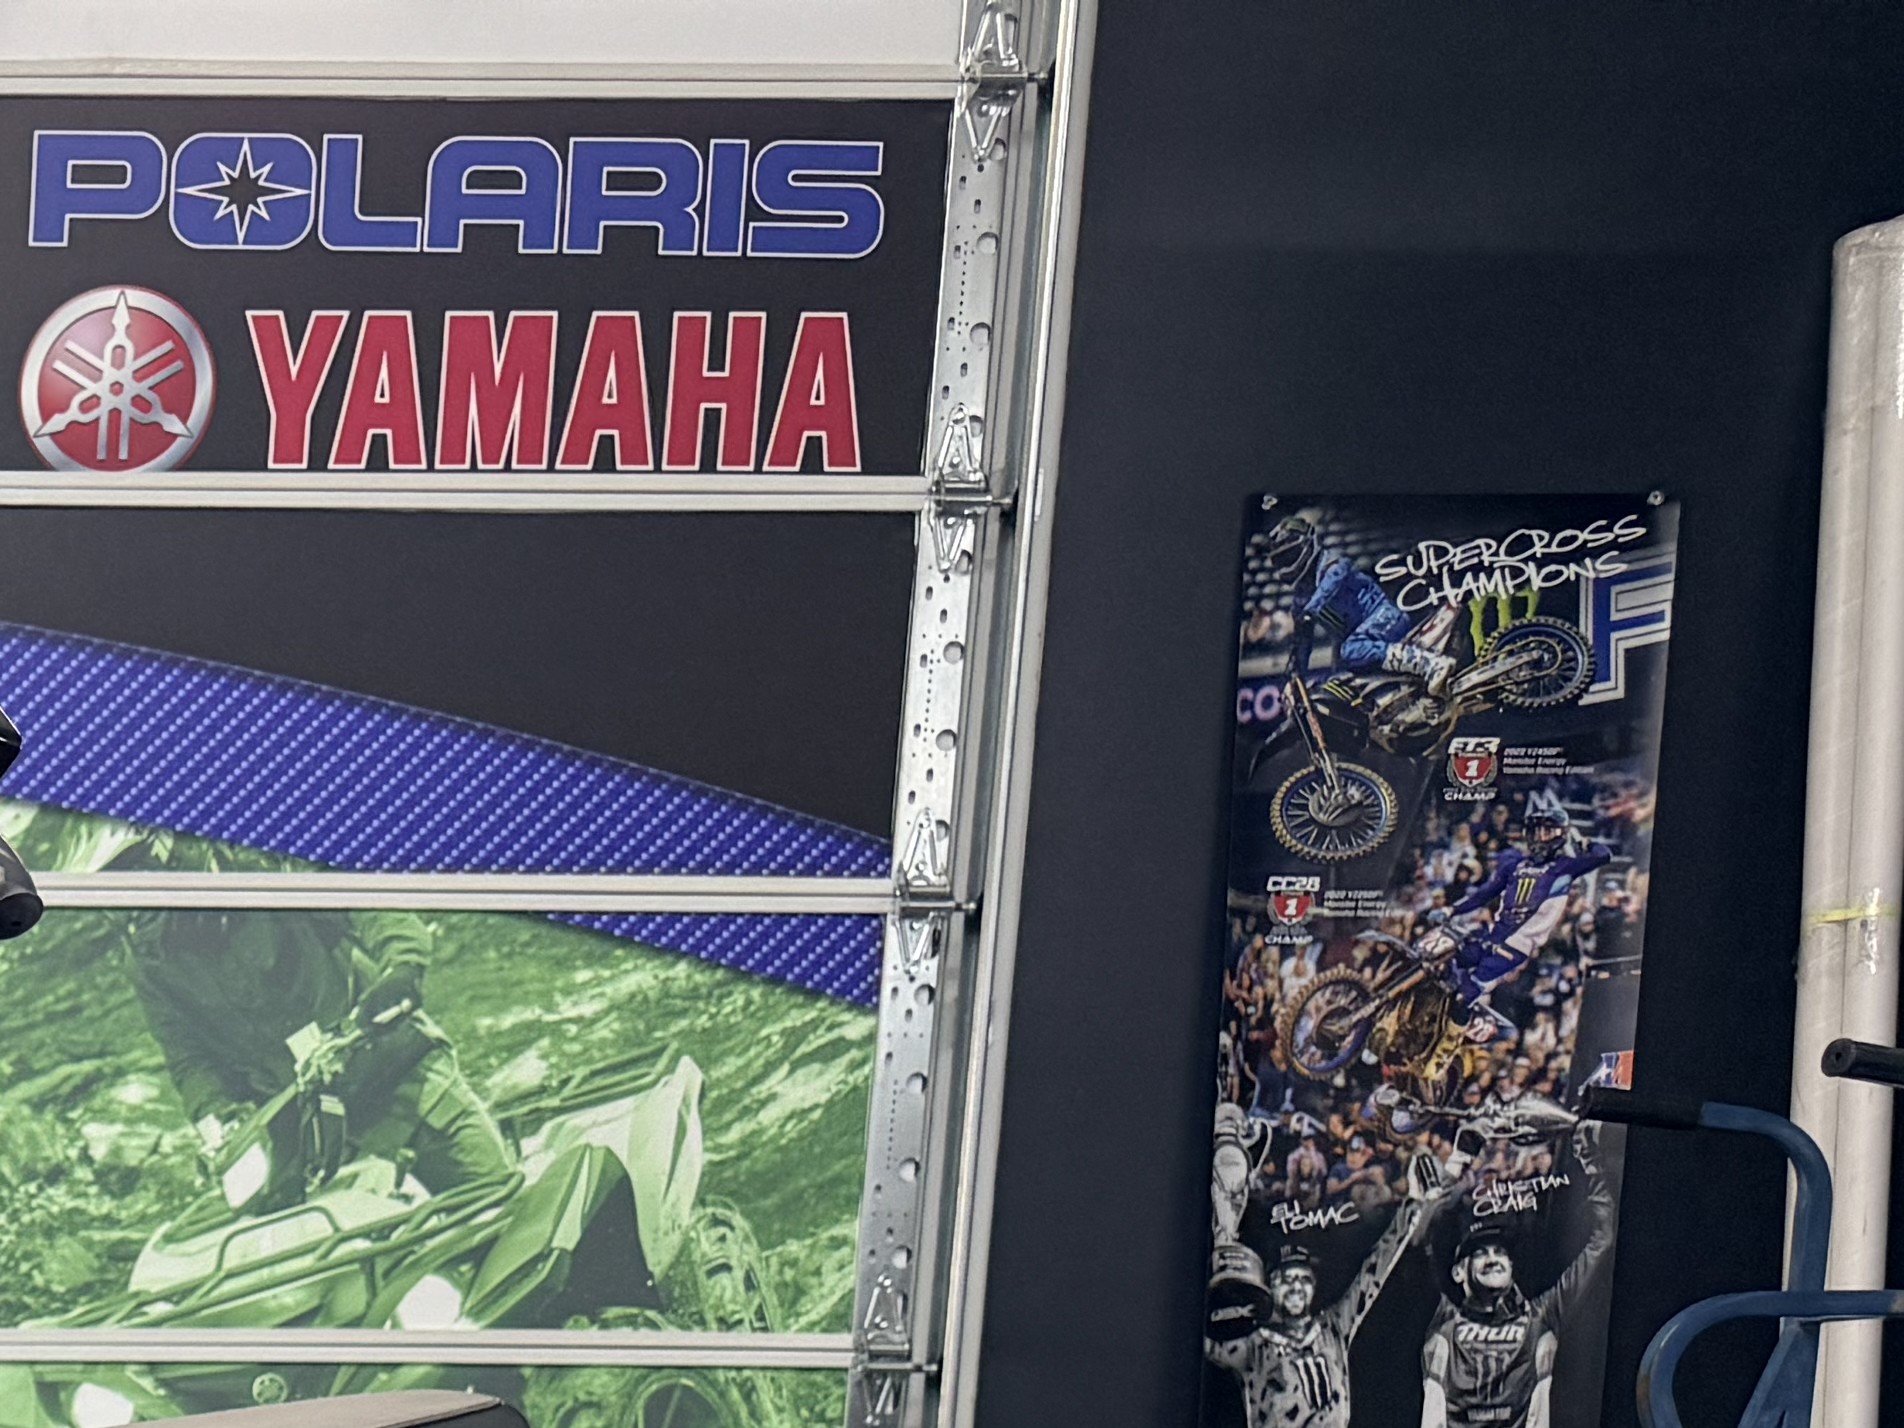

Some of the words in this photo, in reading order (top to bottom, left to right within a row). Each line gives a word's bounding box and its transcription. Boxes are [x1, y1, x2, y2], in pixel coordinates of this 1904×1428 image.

[28, 129, 886, 259] POLARIS
[245, 309, 863, 474] YAMAHA
[1374, 514, 1647, 582] SUPERCROSS
[1396, 550, 1629, 612] CHAMPIONS
[1444, 792, 1496, 801] CHAMP
[1266, 876, 1321, 892] CC28
[1264, 935, 1314, 945] CHAMP
[1471, 1172, 1571, 1202] CHRISTIAN
[1272, 1201, 1360, 1235] TOMAC
[1472, 1192, 1538, 1217] CRAIG
